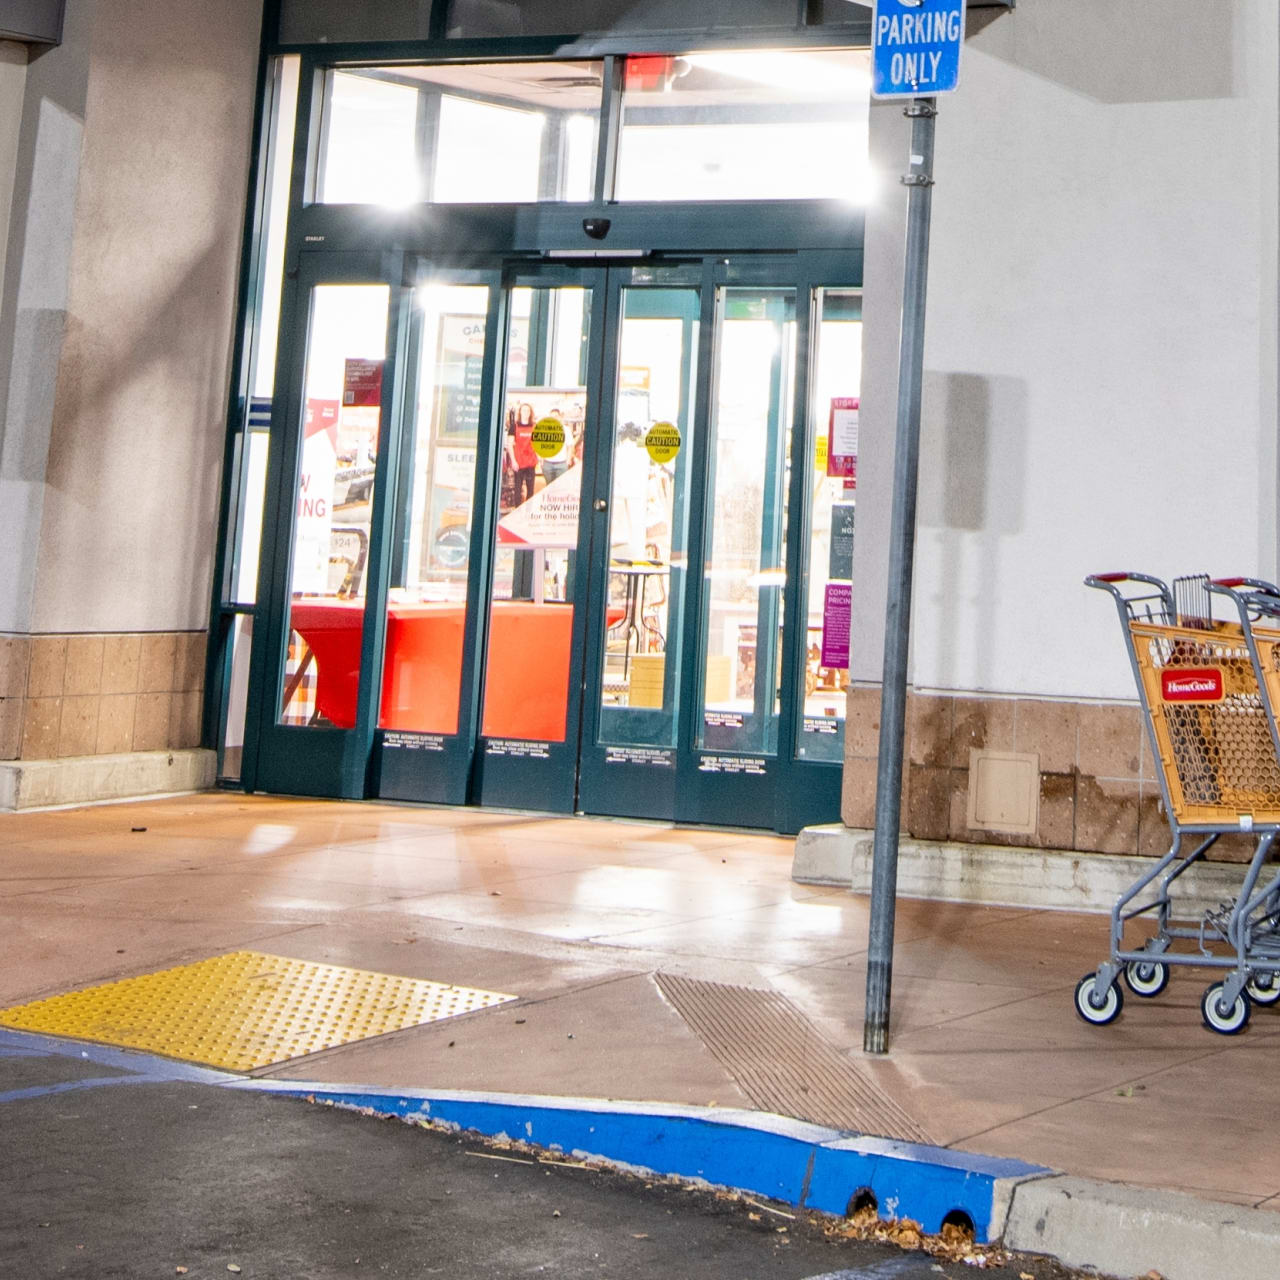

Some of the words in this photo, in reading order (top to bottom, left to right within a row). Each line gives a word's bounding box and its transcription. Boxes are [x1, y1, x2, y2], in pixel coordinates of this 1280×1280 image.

[877, 10, 960, 46] PARKING
[890, 51, 942, 85] ONLY
[532, 432, 564, 442] CAUTION
[647, 437, 679, 446] CAUTION
[447, 454, 476, 463] SLEE
[544, 512, 558, 520] the
[828, 597, 851, 605] PRICIN
[1168, 681, 1216, 693] HomeGoods
